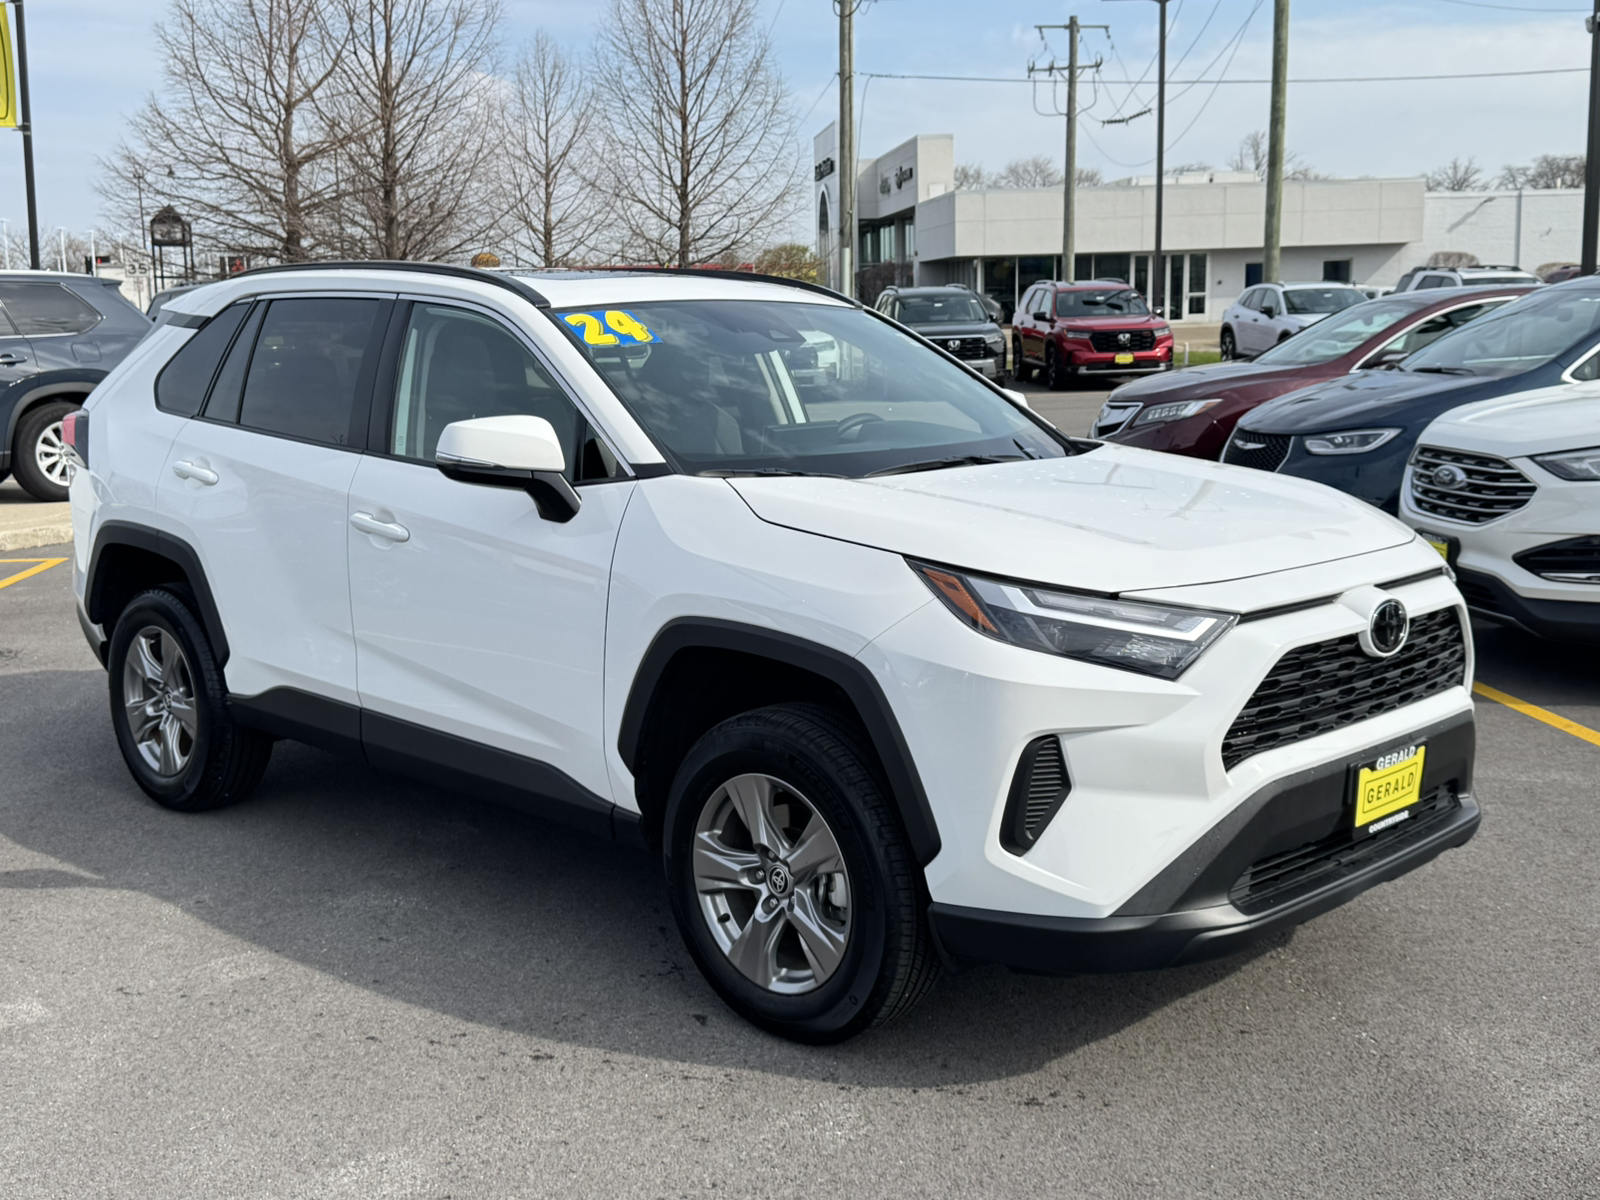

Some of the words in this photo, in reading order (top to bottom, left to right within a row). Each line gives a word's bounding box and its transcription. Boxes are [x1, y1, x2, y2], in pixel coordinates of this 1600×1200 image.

[128, 263, 148, 275] 35
[564, 311, 654, 345] 24
[1375, 745, 1417, 771] GERALD
[1366, 771, 1415, 805] GERALD
